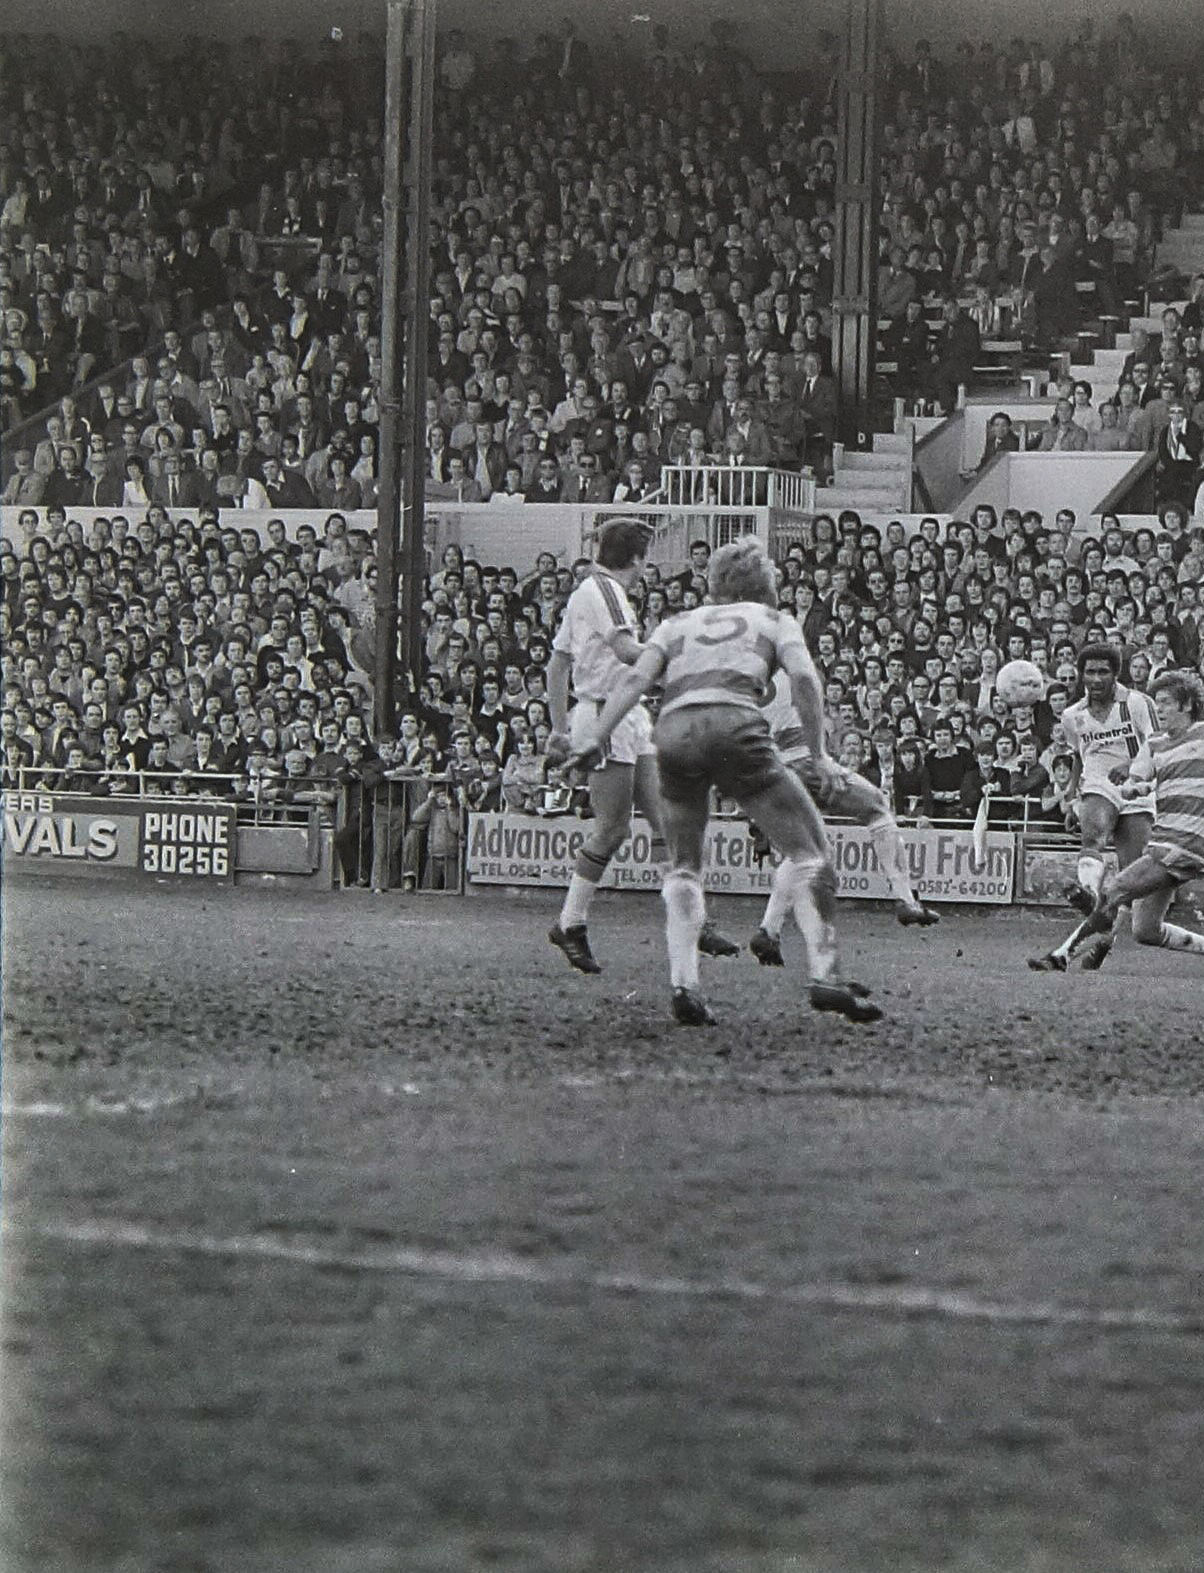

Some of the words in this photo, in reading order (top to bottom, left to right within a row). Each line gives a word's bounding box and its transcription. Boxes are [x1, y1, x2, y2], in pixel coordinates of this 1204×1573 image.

[1081, 723, 1133, 743] Tricentrol
[5, 812, 119, 861] VALS
[144, 812, 229, 844] PHONE
[470, 818, 585, 860] Advance
[143, 843, 229, 876] 30256
